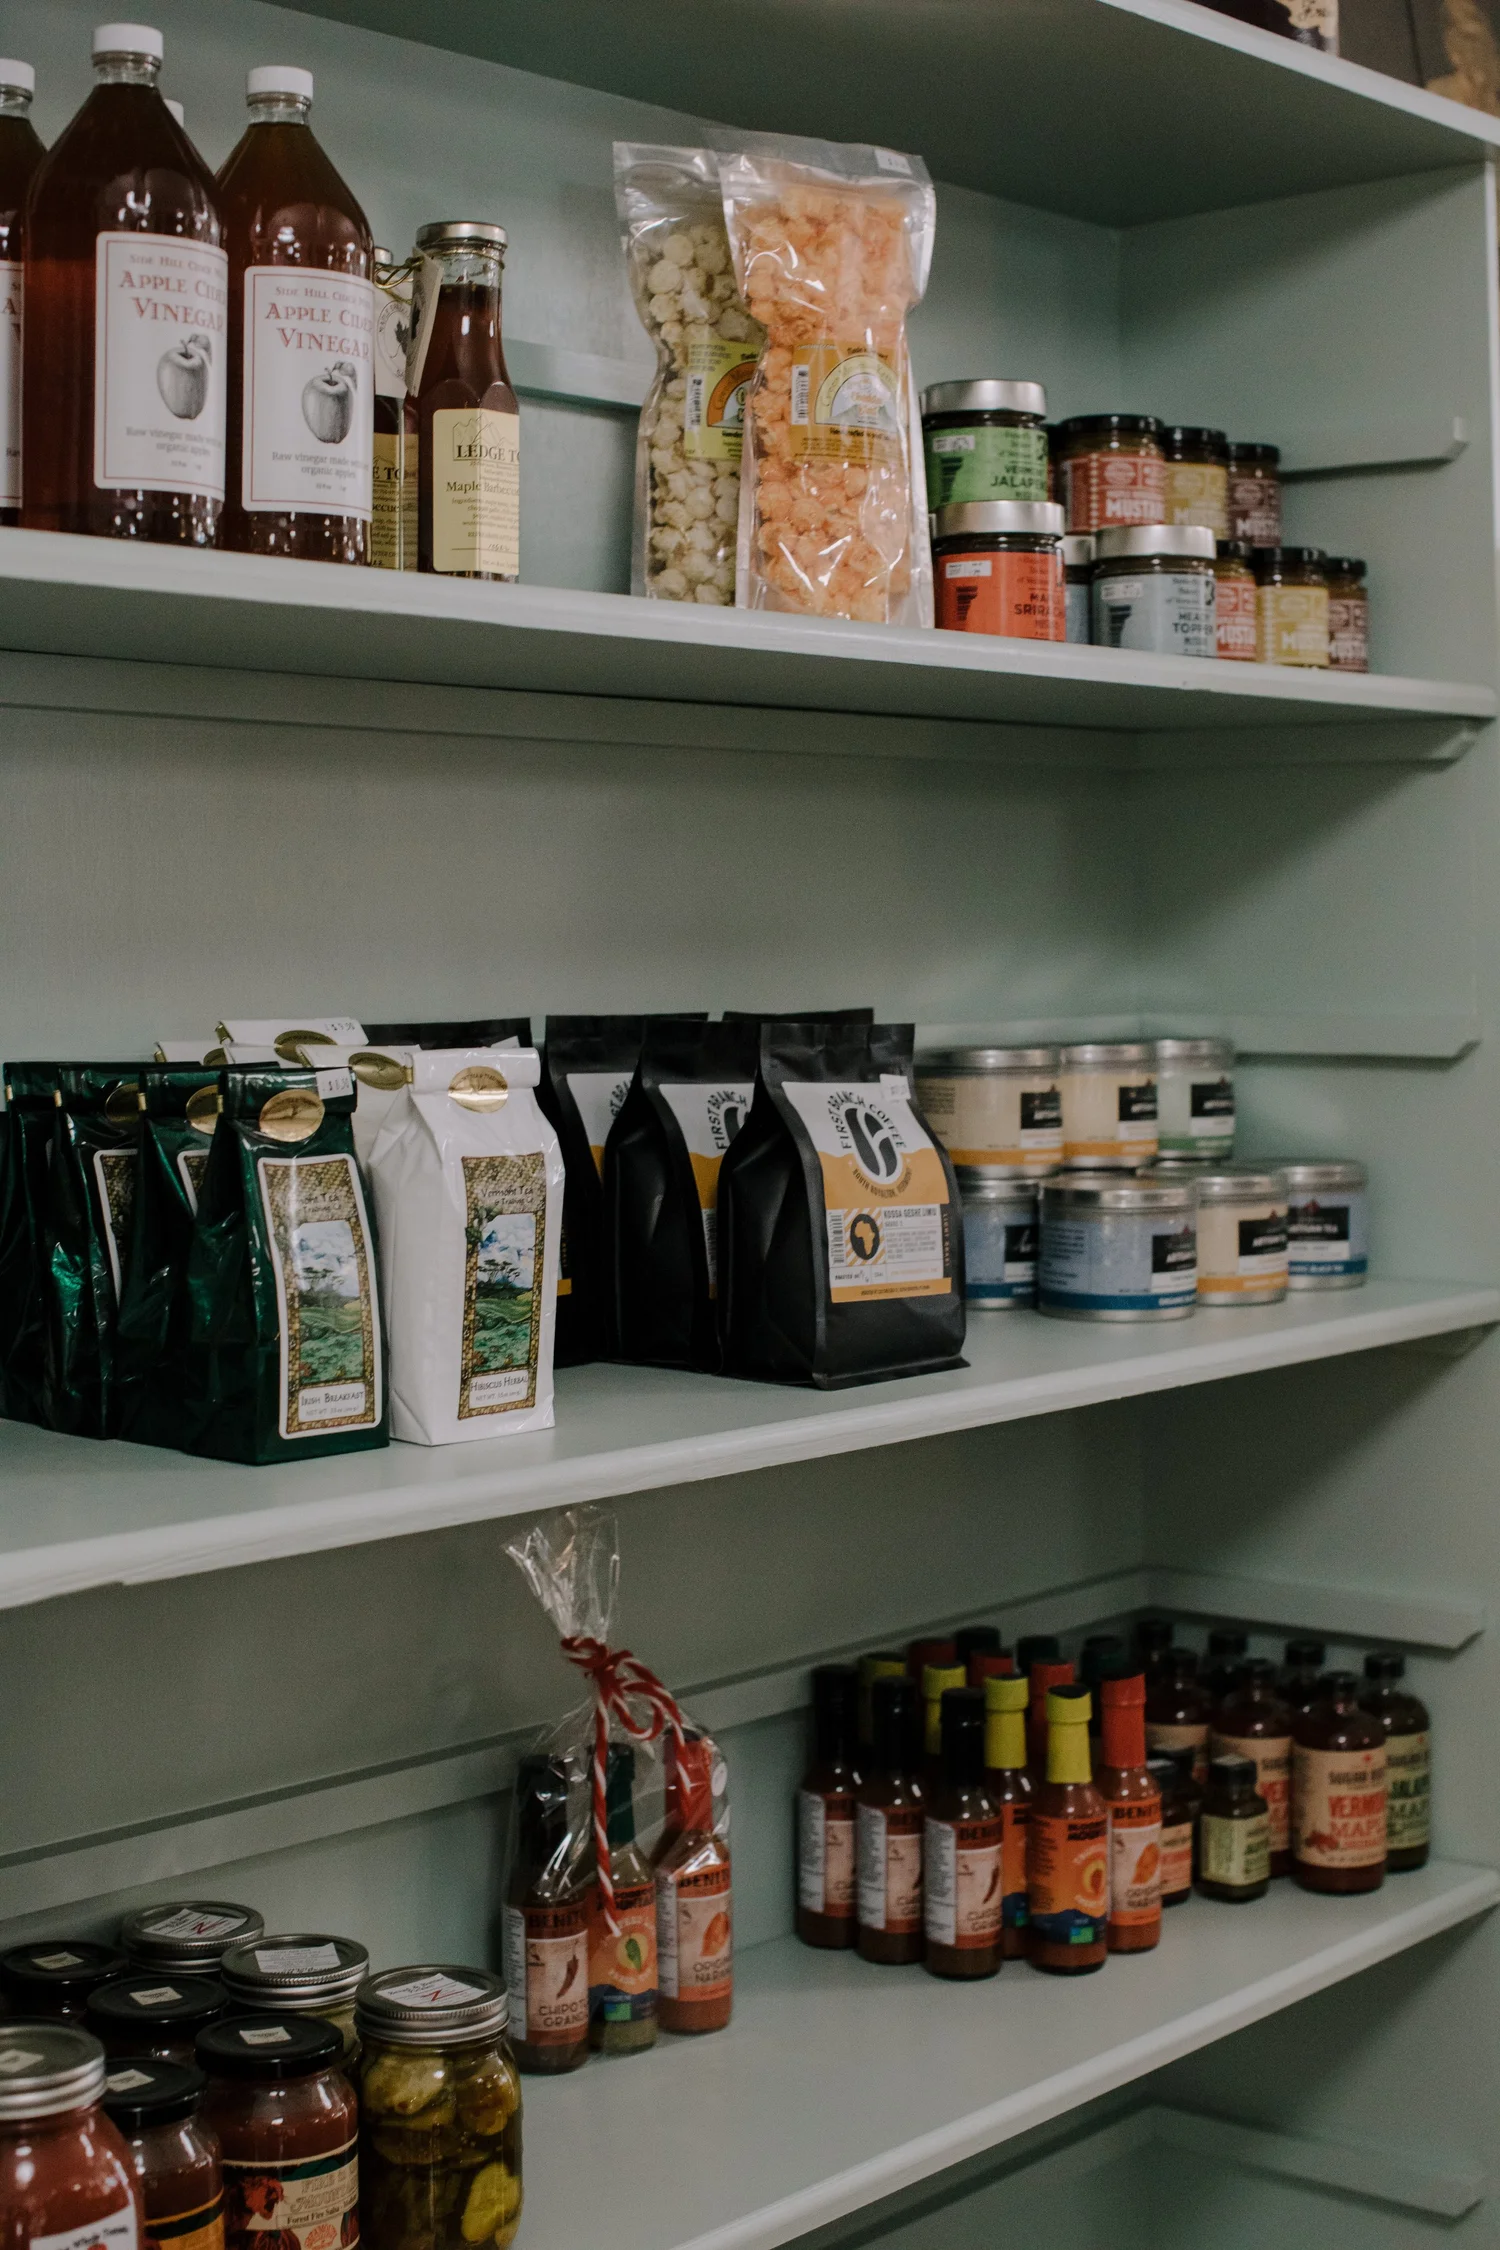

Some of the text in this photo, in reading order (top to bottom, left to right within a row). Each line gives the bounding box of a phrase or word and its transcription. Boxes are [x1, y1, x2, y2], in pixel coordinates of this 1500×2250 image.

[119, 270, 187, 293] APPLE
[304, 287, 330, 300] HILL
[265, 301, 332, 325] APPLE
[276, 326, 371, 361] VINEGAR
[271, 451, 292, 461] Raw
[294, 453, 328, 466] vinegar
[456, 443, 506, 462] LEDGE
[300, 464, 332, 477] organic
[446, 481, 482, 494] Maple
[828, 1107, 852, 1150] FIRST
[869, 1103, 908, 1149] COFFEE
[480, 1185, 534, 1198] Vermont Tea
[470, 1375, 529, 1392] HIBISCUS HERBAL
[301, 1391, 364, 1407] IRISH BREAKFAST
[538, 1998, 588, 2016] CHIPOT
[286, 2210, 310, 2225] Forest
[311, 2206, 325, 2221] Fire
